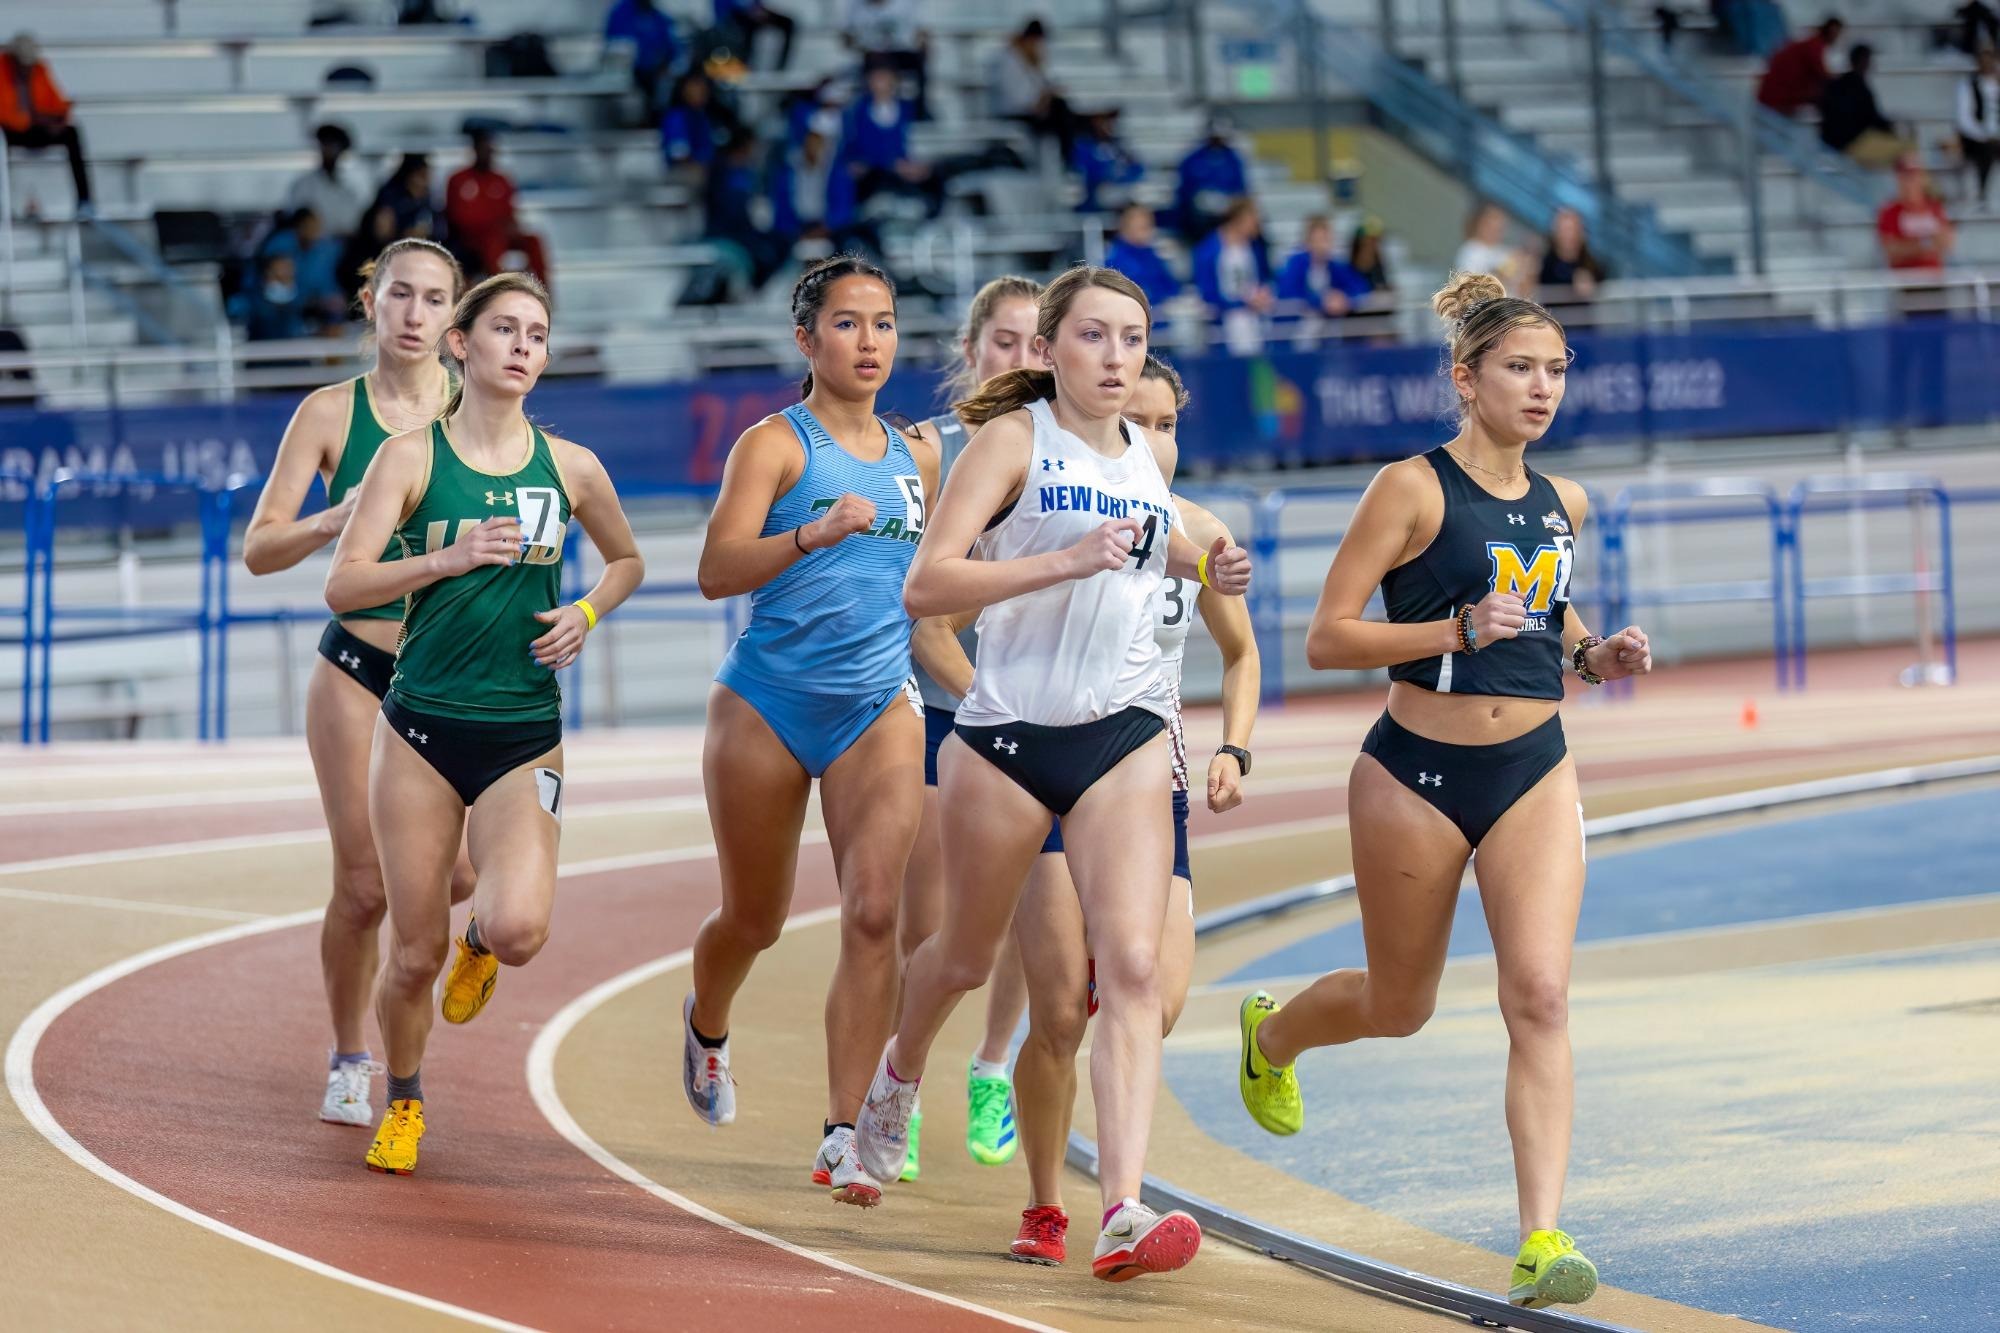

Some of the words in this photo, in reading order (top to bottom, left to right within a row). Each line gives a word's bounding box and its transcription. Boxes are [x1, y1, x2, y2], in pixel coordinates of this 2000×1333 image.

[1314, 374, 1391, 428] THE
[162, 437, 260, 492] USA
[526, 491, 551, 542] 7
[904, 478, 923, 529] 5
[1040, 486, 1092, 512] NEW
[1128, 515, 1158, 569] 4
[1163, 576, 1183, 625] 3
[1486, 542, 1562, 617] M
[543, 769, 562, 814] 7
